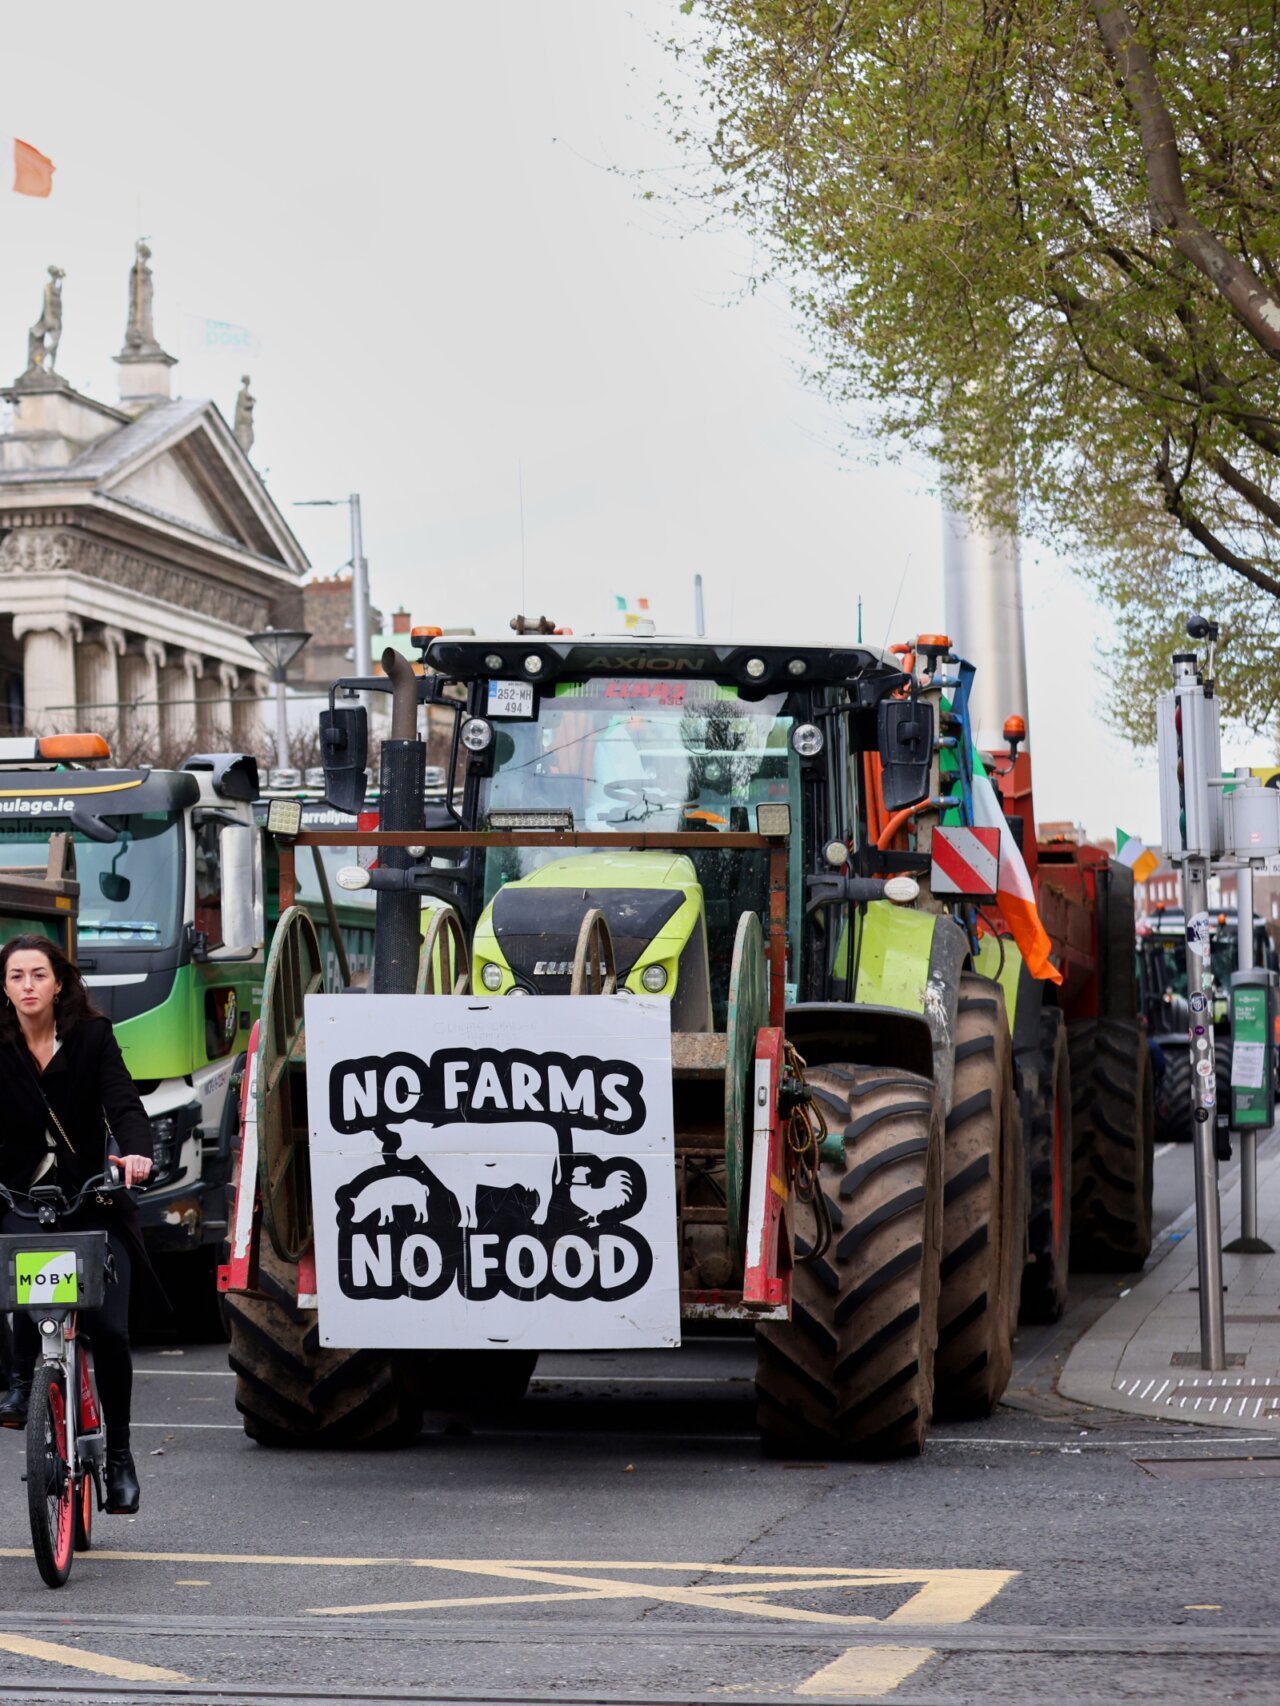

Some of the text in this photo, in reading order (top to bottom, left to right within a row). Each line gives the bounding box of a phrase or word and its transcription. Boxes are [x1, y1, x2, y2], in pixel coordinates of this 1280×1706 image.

[497, 689, 532, 700] 252-MH
[505, 702, 523, 713] 494
[342, 1061, 633, 1121] NO FARMS
[351, 1233, 639, 1289] NO FOOD
[20, 1273, 74, 1286] MOBY
